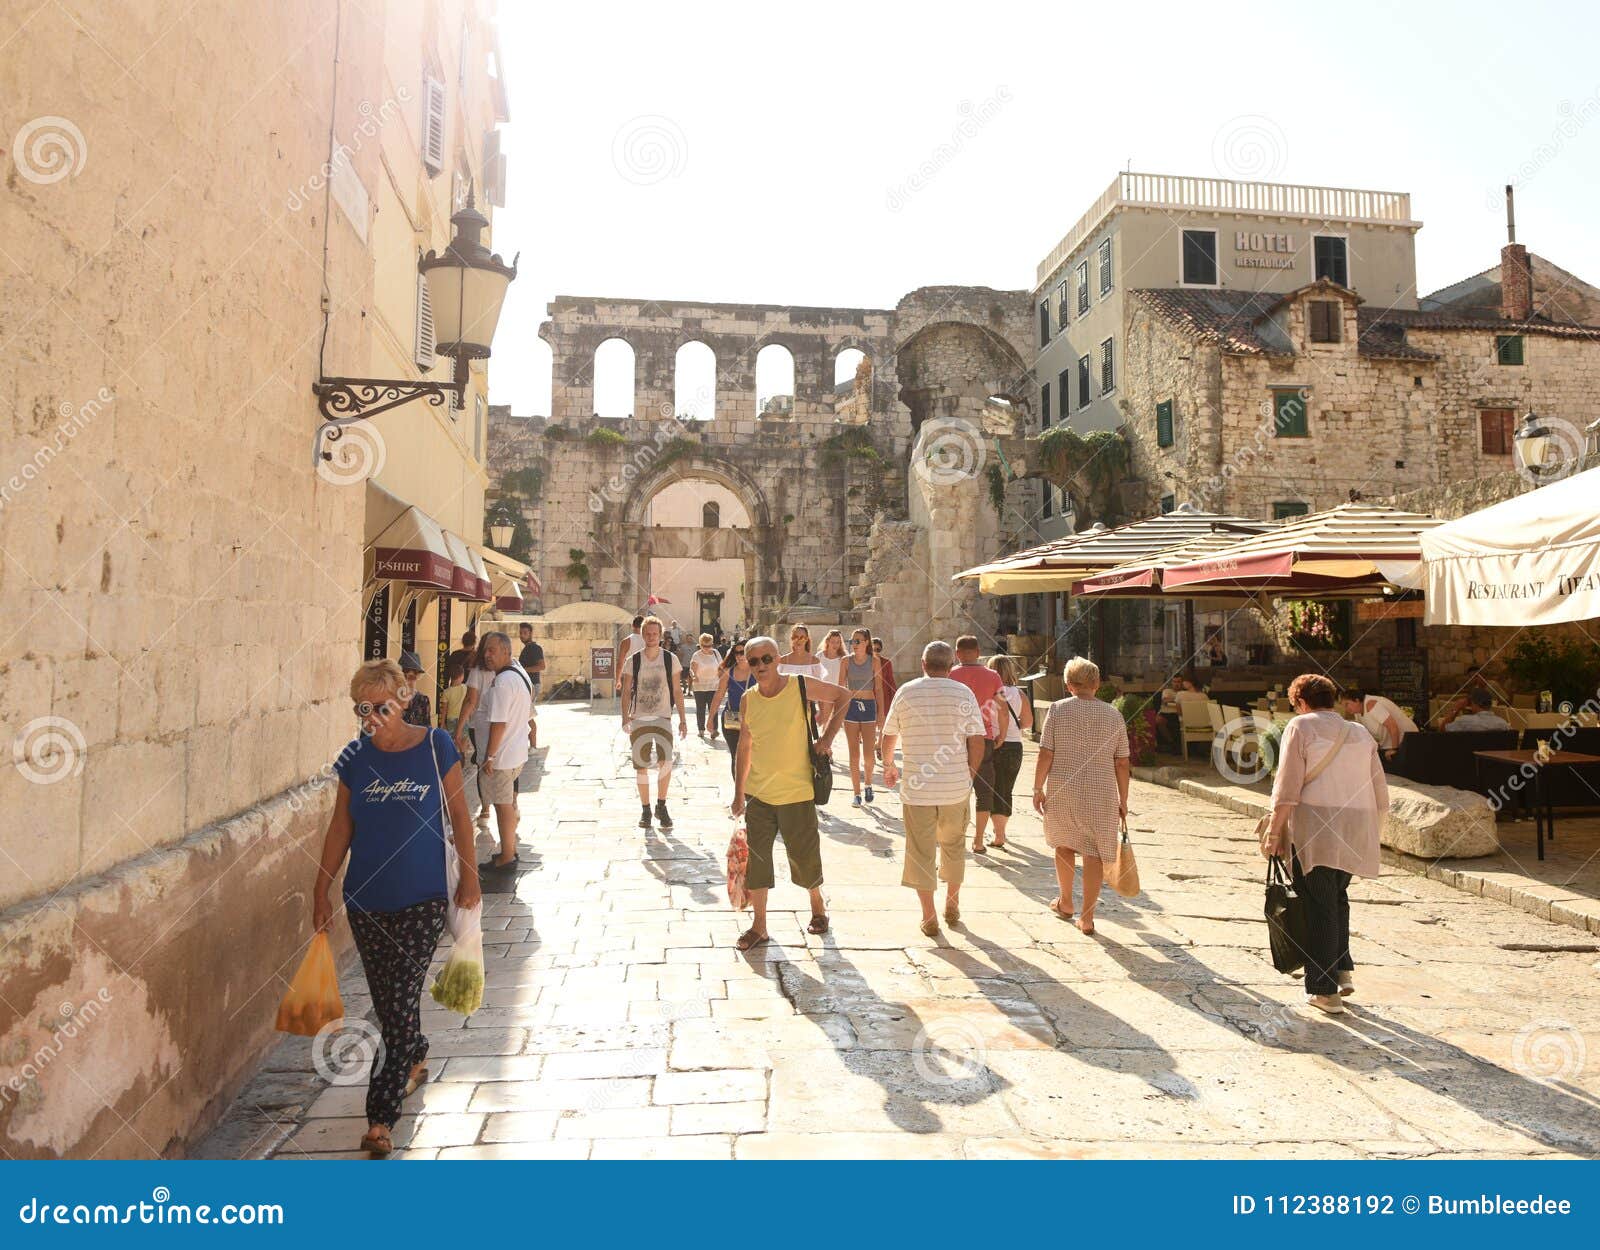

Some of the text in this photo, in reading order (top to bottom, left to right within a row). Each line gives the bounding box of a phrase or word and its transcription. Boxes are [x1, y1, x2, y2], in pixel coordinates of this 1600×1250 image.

[1235, 231, 1297, 254] HOTEL
[376, 560, 421, 572] T-SHIRT
[1467, 580, 1545, 600] RESTAURANT
[361, 777, 431, 802] Anything
